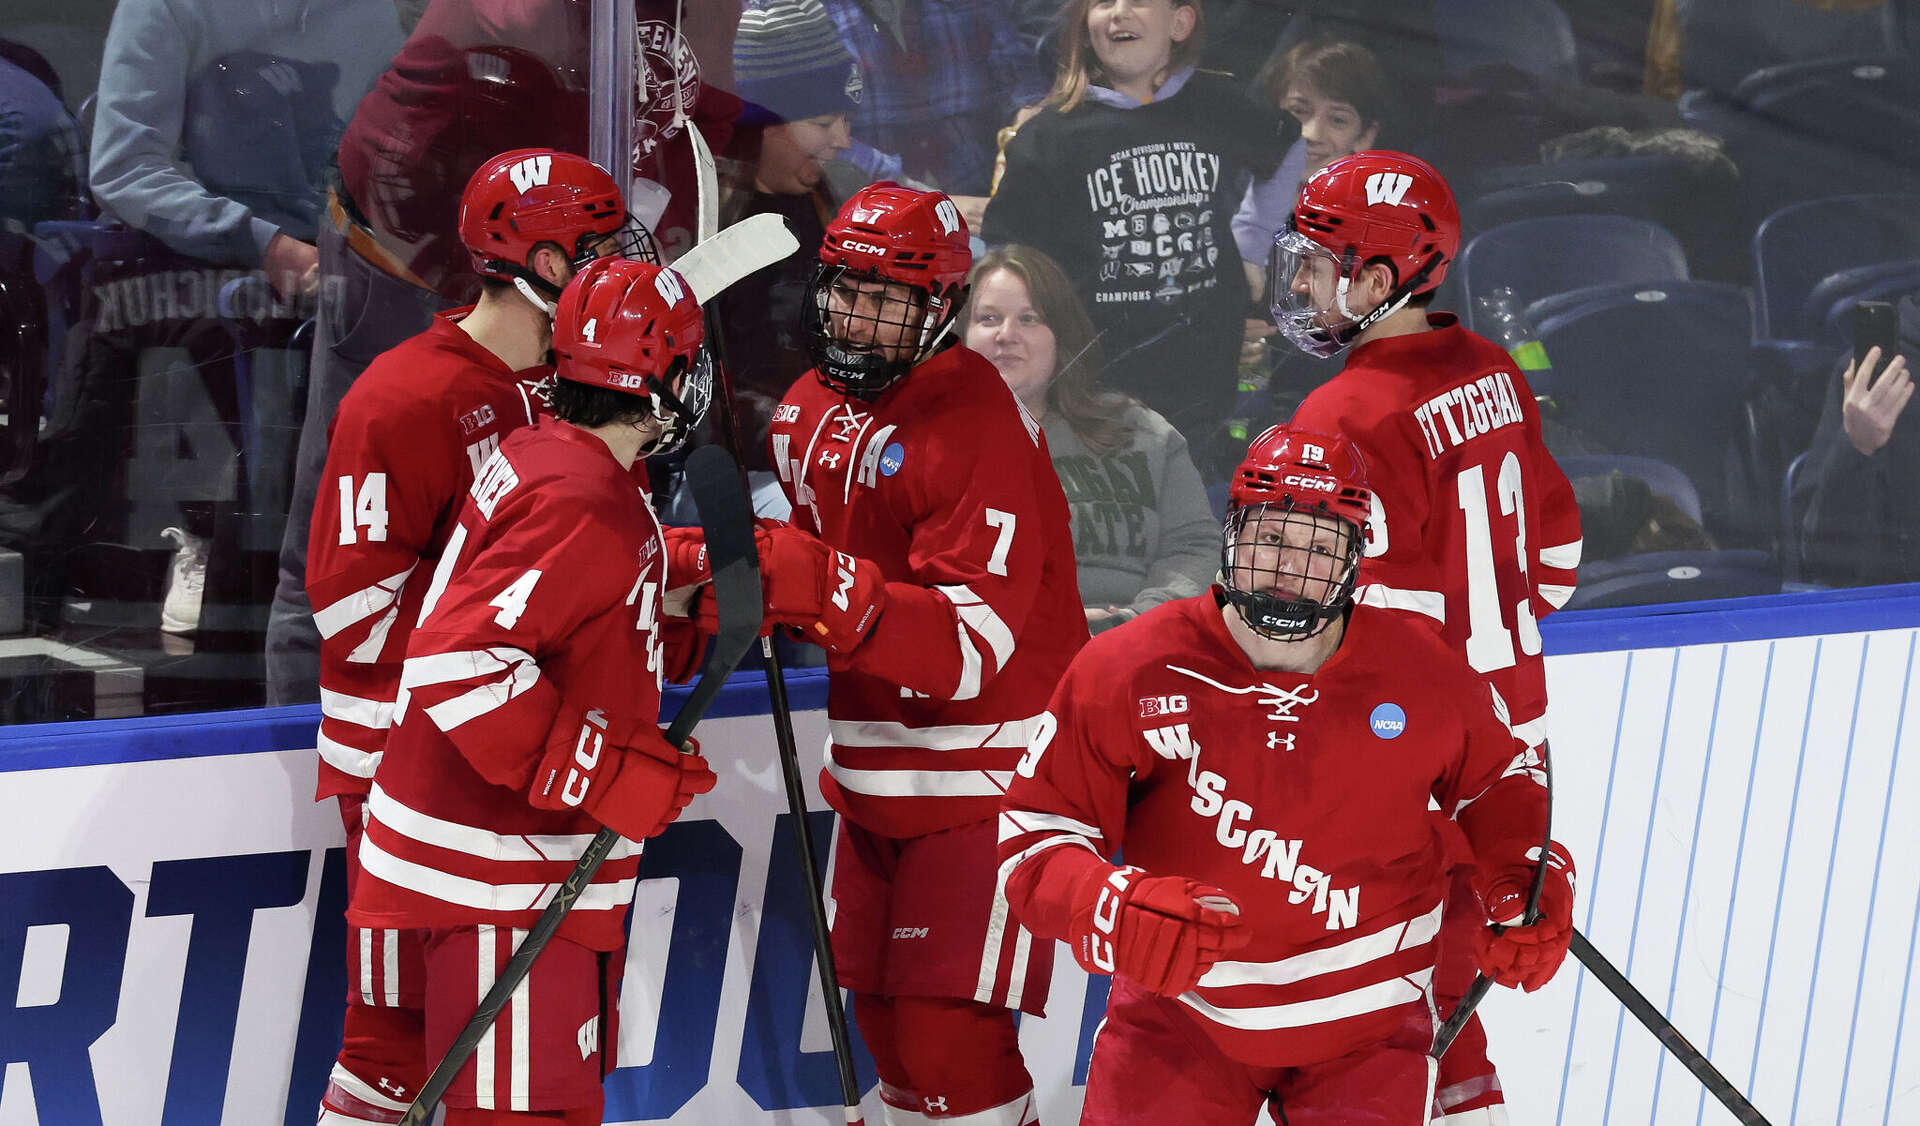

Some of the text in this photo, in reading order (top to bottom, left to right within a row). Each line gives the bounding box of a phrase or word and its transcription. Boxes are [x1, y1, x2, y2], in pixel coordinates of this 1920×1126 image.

[509, 155, 553, 196] W
[1087, 151, 1221, 212] ICE HOCKEY
[1364, 172, 1415, 208] W
[934, 199, 961, 237] W
[841, 239, 887, 258] CCM
[654, 266, 686, 312] W
[1095, 290, 1151, 303] CHAMPIONS
[582, 318, 598, 343] 4
[1359, 301, 1391, 332] CCM
[1301, 443, 1325, 462] 19
[1283, 474, 1338, 493] CCM
[338, 472, 389, 546] 14
[985, 507, 1017, 577] 7
[1456, 450, 1544, 675] 13
[487, 568, 543, 631] 4
[1373, 718, 1404, 732] NCAA
[1015, 710, 1059, 780] 9
[1142, 723, 1362, 931] WISCONSIN
[892, 926, 930, 940] CCM
[1091, 864, 1148, 974] CCM
